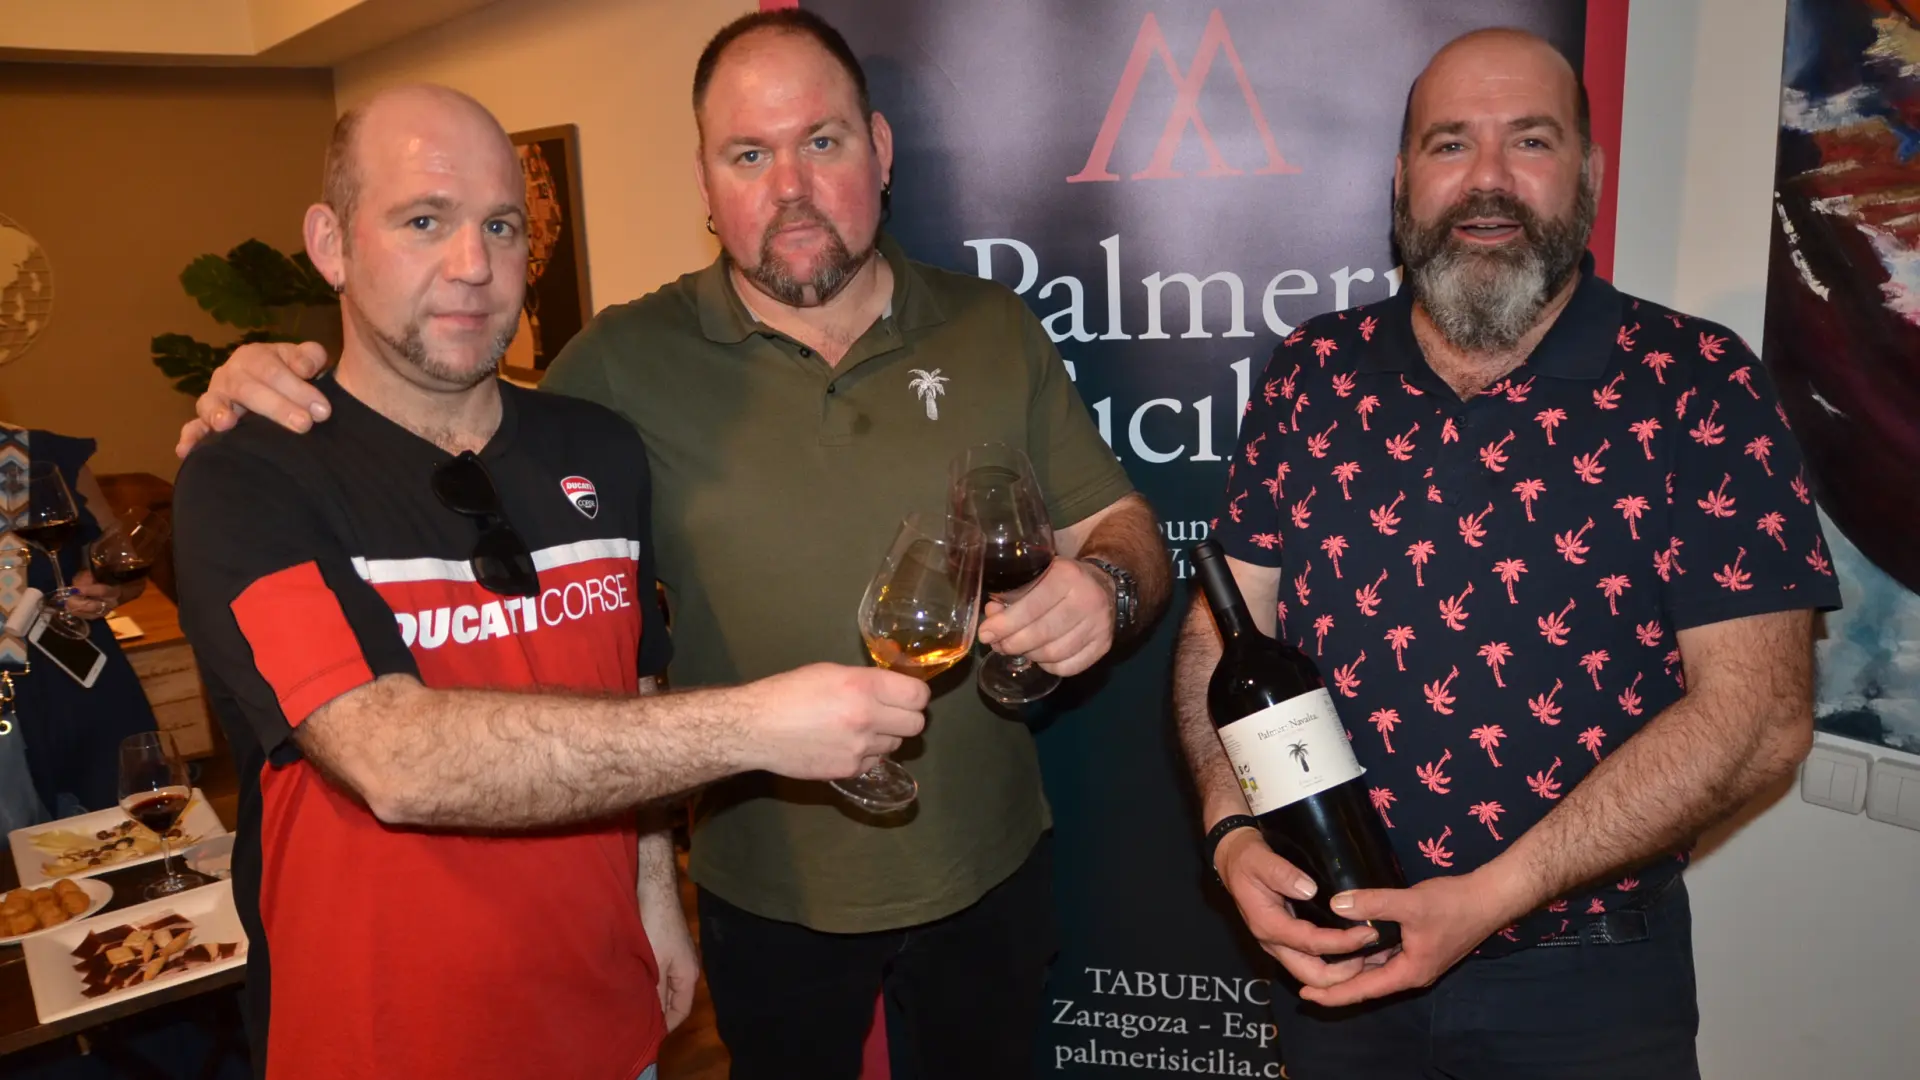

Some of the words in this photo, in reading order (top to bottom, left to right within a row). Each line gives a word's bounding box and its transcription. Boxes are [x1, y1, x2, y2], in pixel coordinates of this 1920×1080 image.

[963, 233, 1403, 341] Palmer
[1063, 357, 1250, 463] icil
[565, 482, 593, 490] DUCATI
[1157, 519, 1209, 541] un
[394, 596, 538, 650] DUCATI
[540, 573, 631, 627] CORSE
[1084, 966, 1271, 1006] TABUENC
[1052, 999, 1189, 1038] Zaragoza
[1222, 1011, 1278, 1049] Esp
